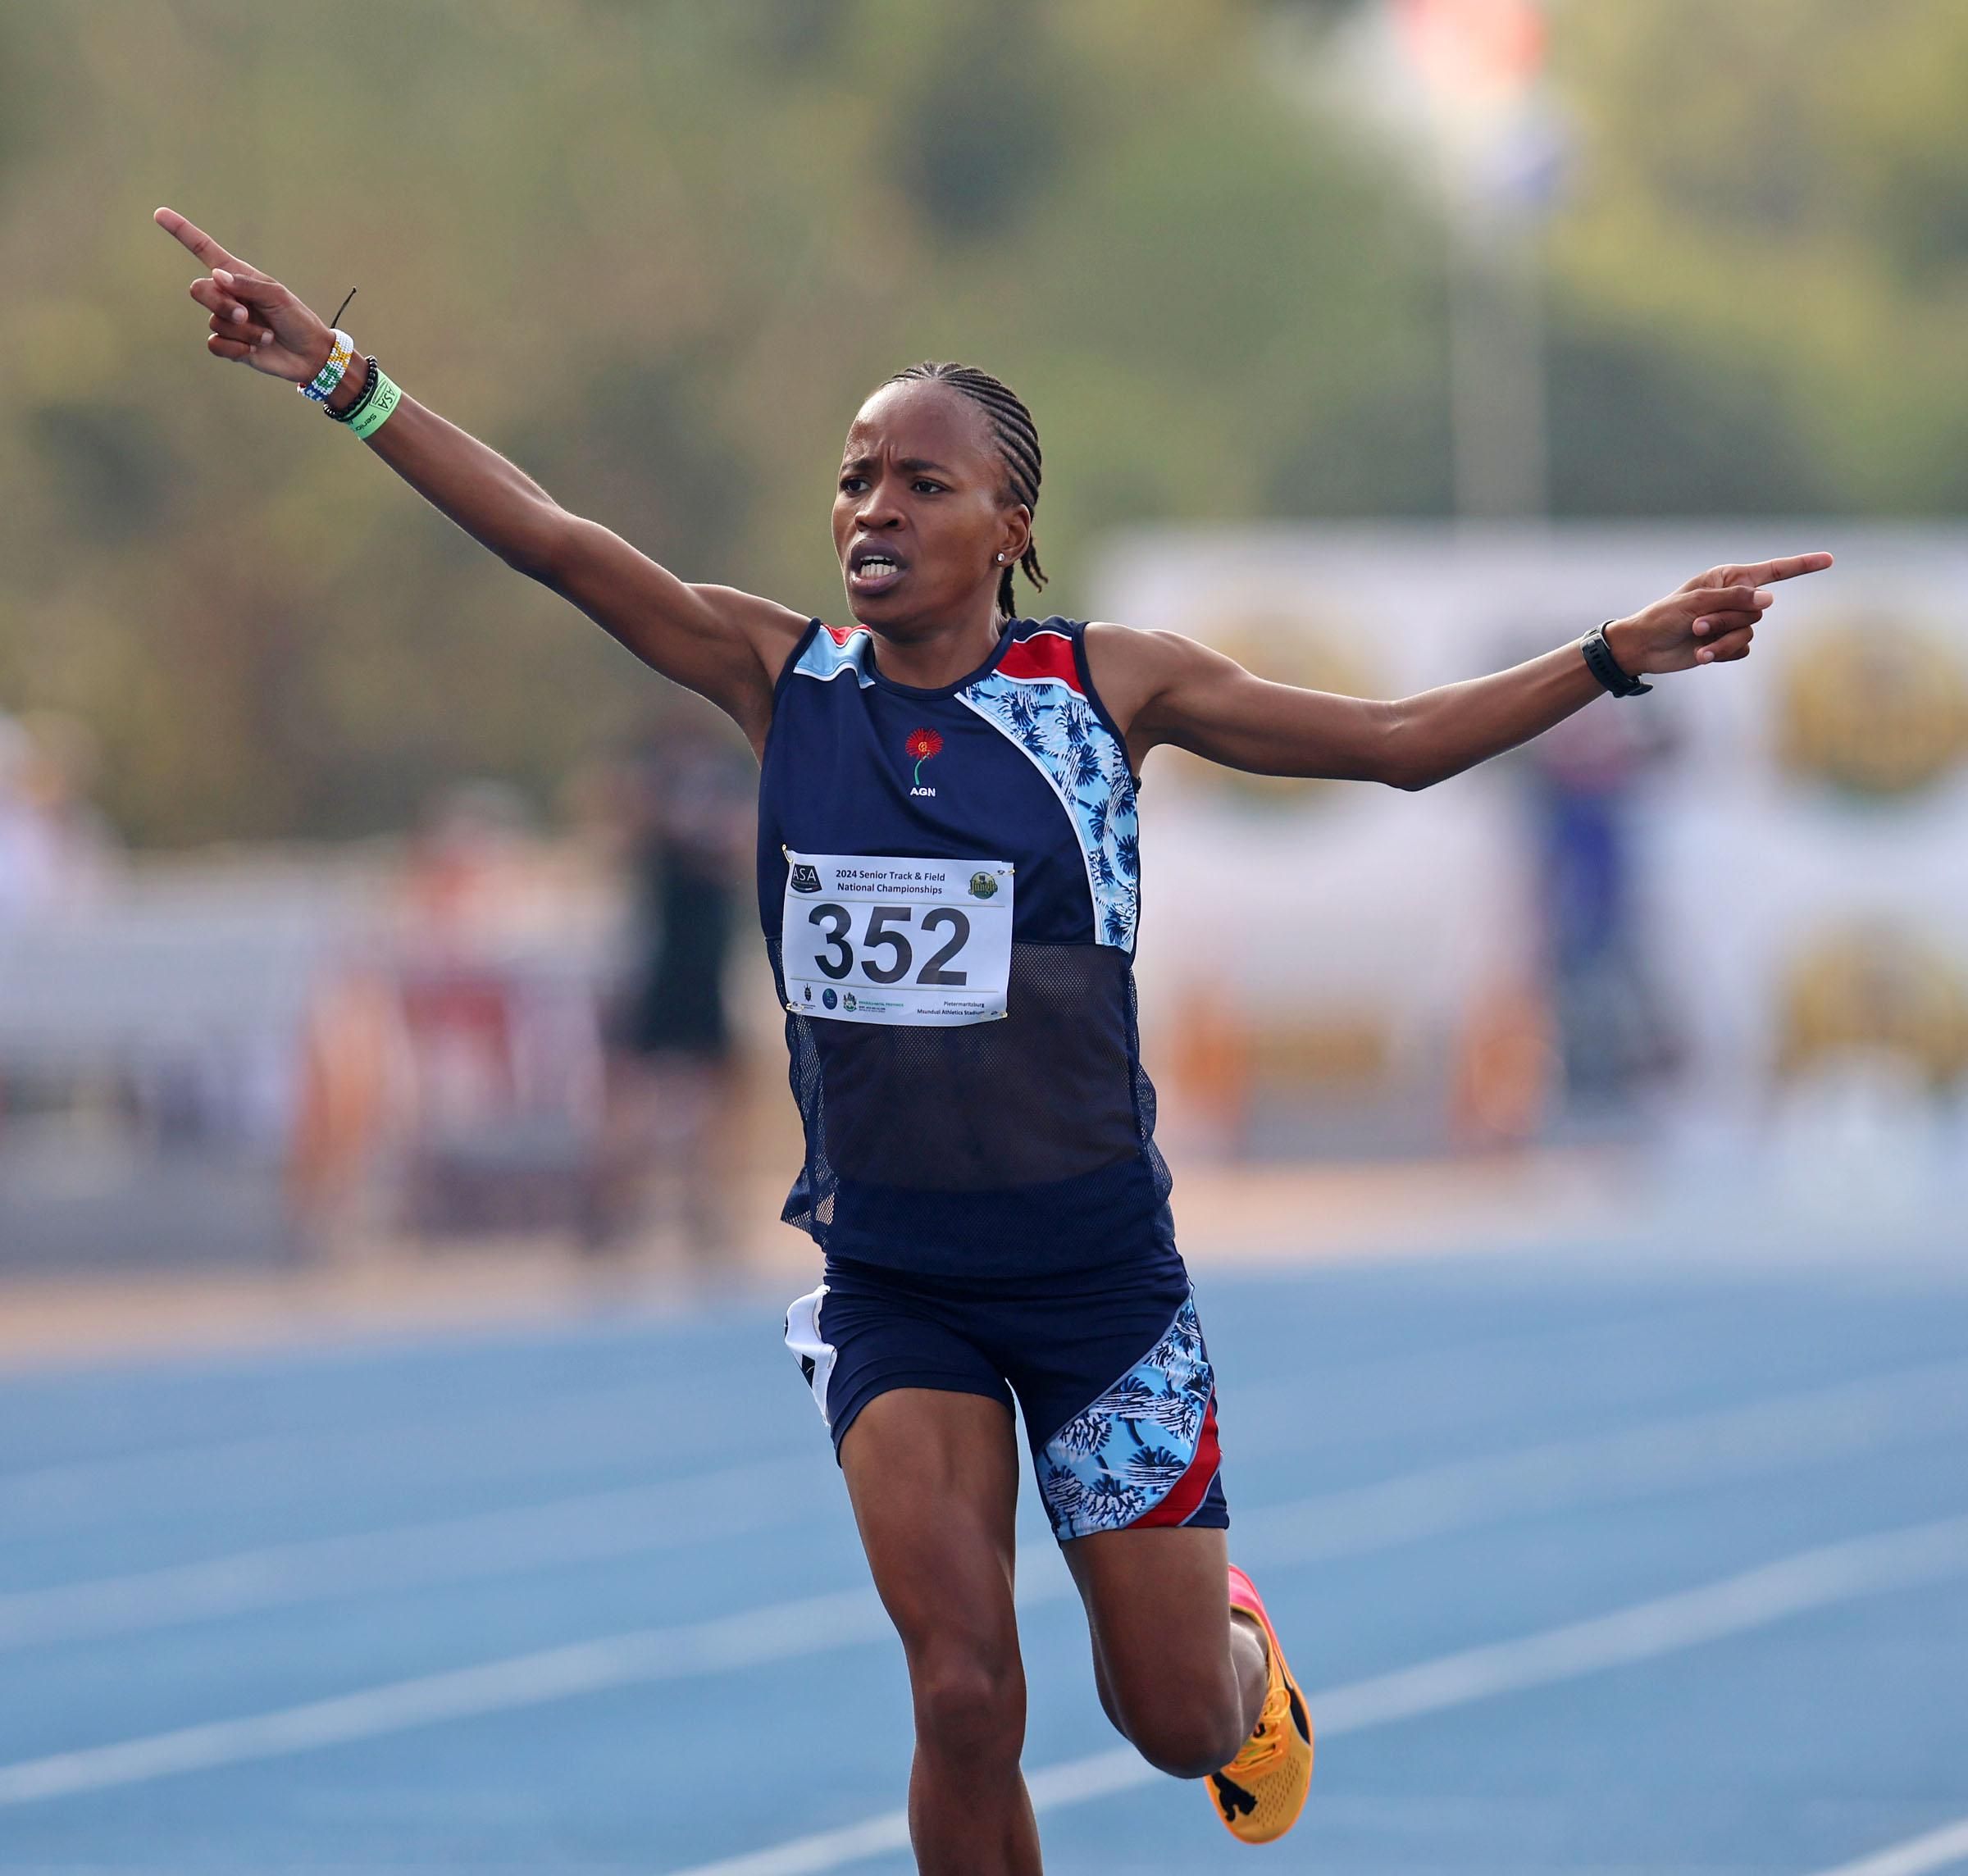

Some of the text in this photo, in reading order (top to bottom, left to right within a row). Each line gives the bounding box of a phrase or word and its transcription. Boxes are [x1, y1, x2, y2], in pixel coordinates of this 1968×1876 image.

[378, 385, 395, 409] ASA
[355, 413, 377, 431] Senio
[909, 787, 936, 797] AGN
[792, 866, 817, 882] ASA
[836, 869, 945, 881] 2024 Senior Track & Field
[837, 883, 942, 895] National Championships
[968, 879, 998, 895] Jungle
[809, 903, 970, 986] 352
